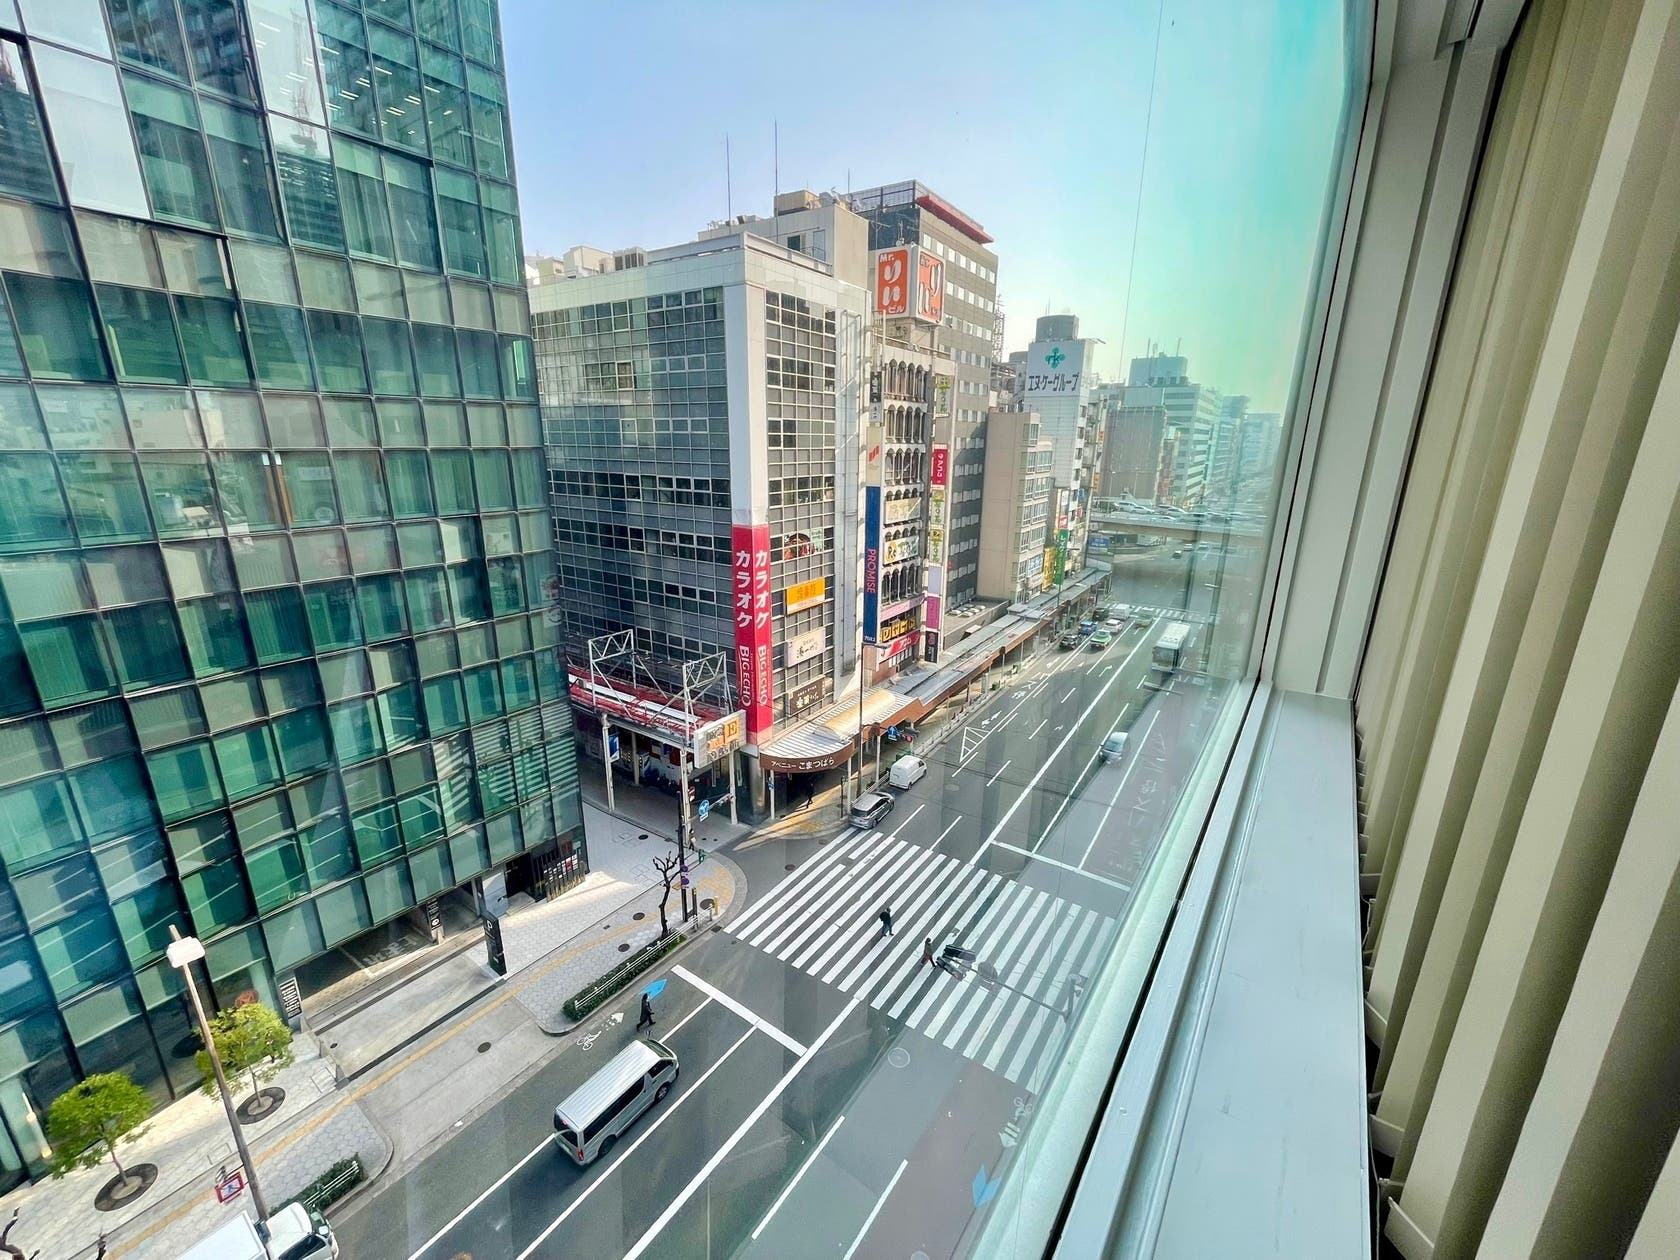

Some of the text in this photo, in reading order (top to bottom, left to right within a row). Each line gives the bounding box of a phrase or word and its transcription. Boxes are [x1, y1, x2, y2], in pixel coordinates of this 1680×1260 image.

[879, 253, 895, 263] Mr.
[735, 550, 753, 629] カラオケ
[755, 549, 770, 630] カラオケ
[866, 548, 876, 594] PROMISE
[739, 645, 752, 707] BIG ECHO
[757, 644, 768, 707] BIG ECHO
[798, 757, 835, 770] こまつばら
